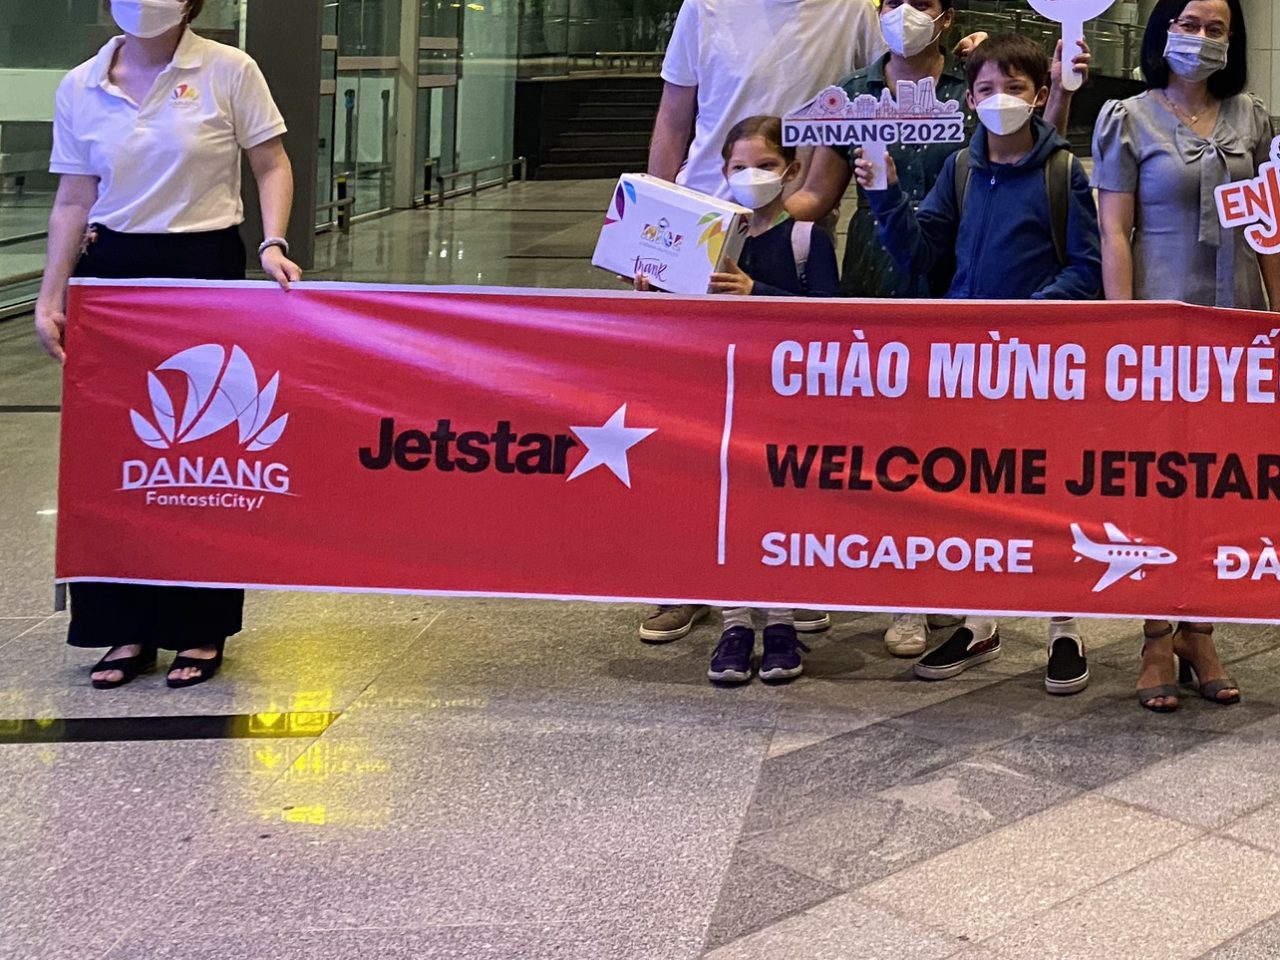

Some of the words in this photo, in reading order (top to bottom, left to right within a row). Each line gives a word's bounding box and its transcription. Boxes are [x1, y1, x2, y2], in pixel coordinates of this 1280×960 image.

[902, 123, 962, 141] 2022
[771, 330, 909, 398] CHÀO
[928, 331, 1086, 401] MỪNG
[358, 417, 578, 475] Jetstar
[765, 443, 1047, 496] WELCOME
[122, 456, 289, 494] DANANG
[761, 531, 1034, 575] SINGAPORE
